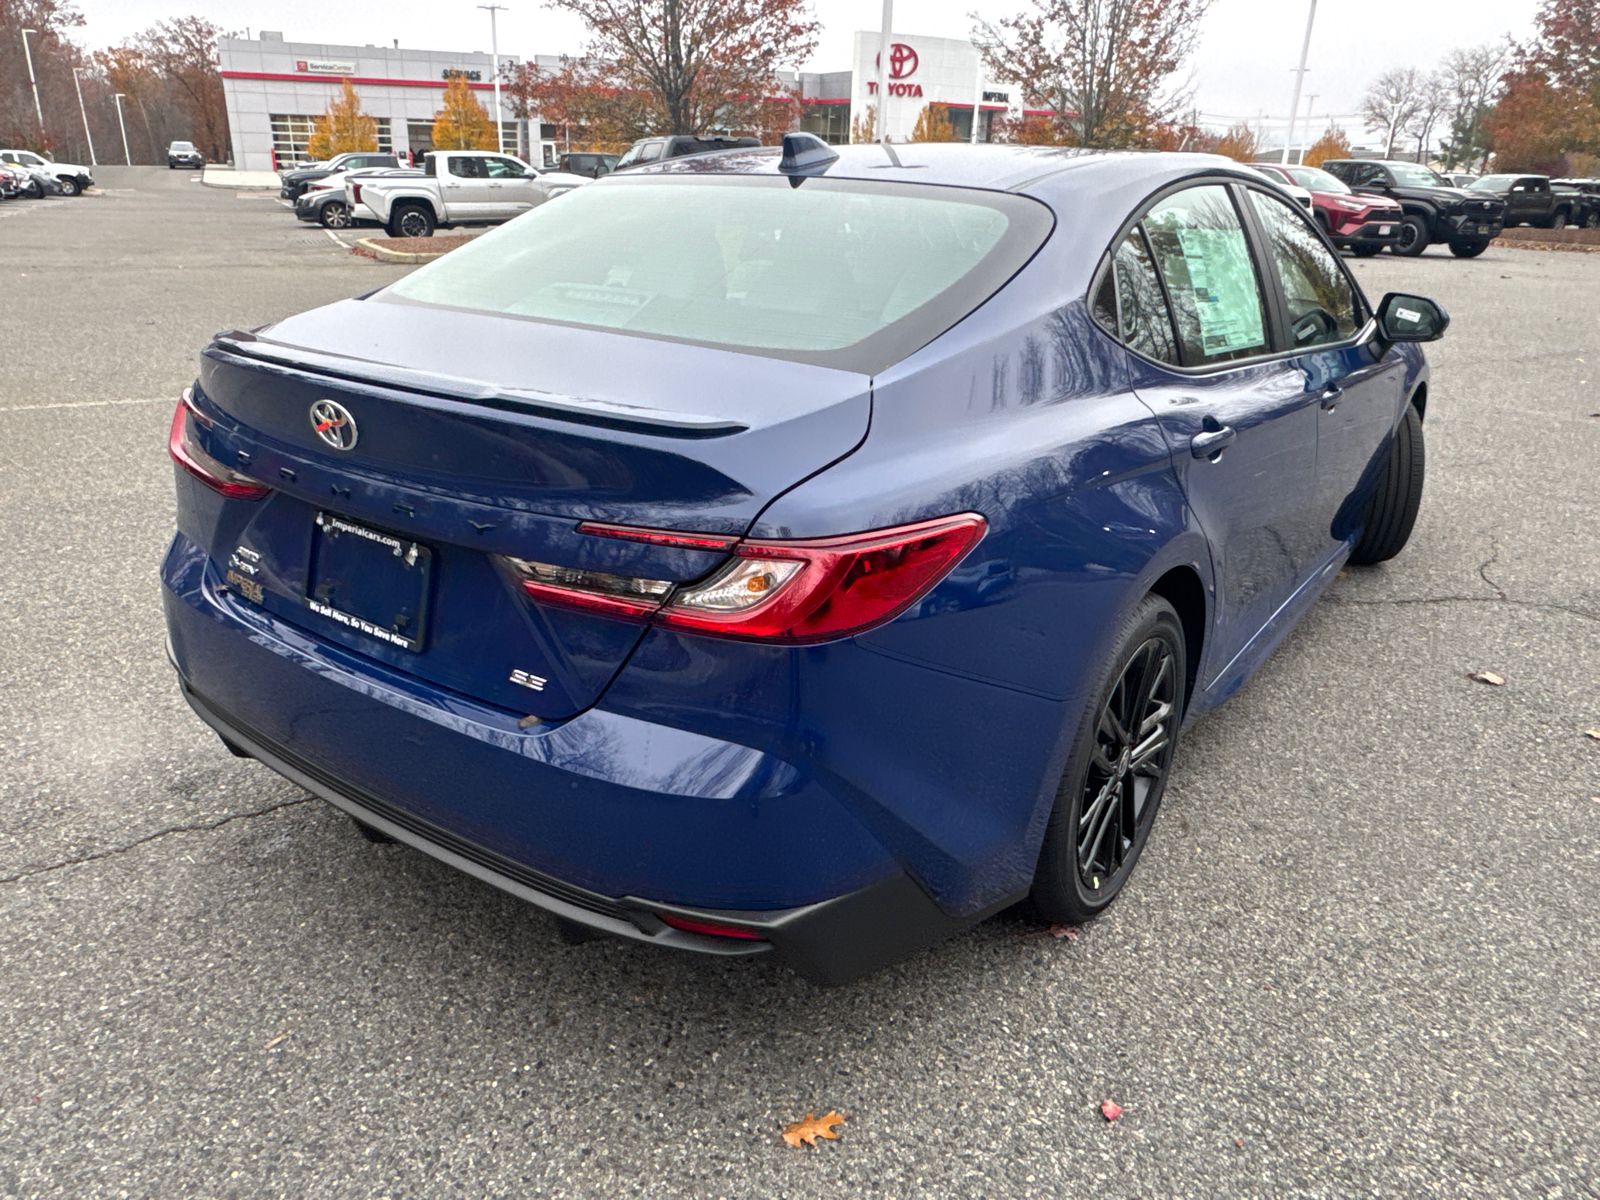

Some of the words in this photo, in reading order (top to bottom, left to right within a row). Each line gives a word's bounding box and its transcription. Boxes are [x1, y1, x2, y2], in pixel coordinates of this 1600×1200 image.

[867, 81, 923, 98] TYOTA
[982, 91, 1009, 103] IMPERIAL
[332, 518, 401, 548] Imperialcars.com
[309, 601, 320, 612] We
[320, 605, 331, 615] Sell
[332, 609, 350, 626] More,
[350, 617, 360, 628] So
[360, 622, 373, 633] You
[373, 627, 390, 641] Save
[390, 634, 409, 649] More
[509, 669, 547, 691] SE
